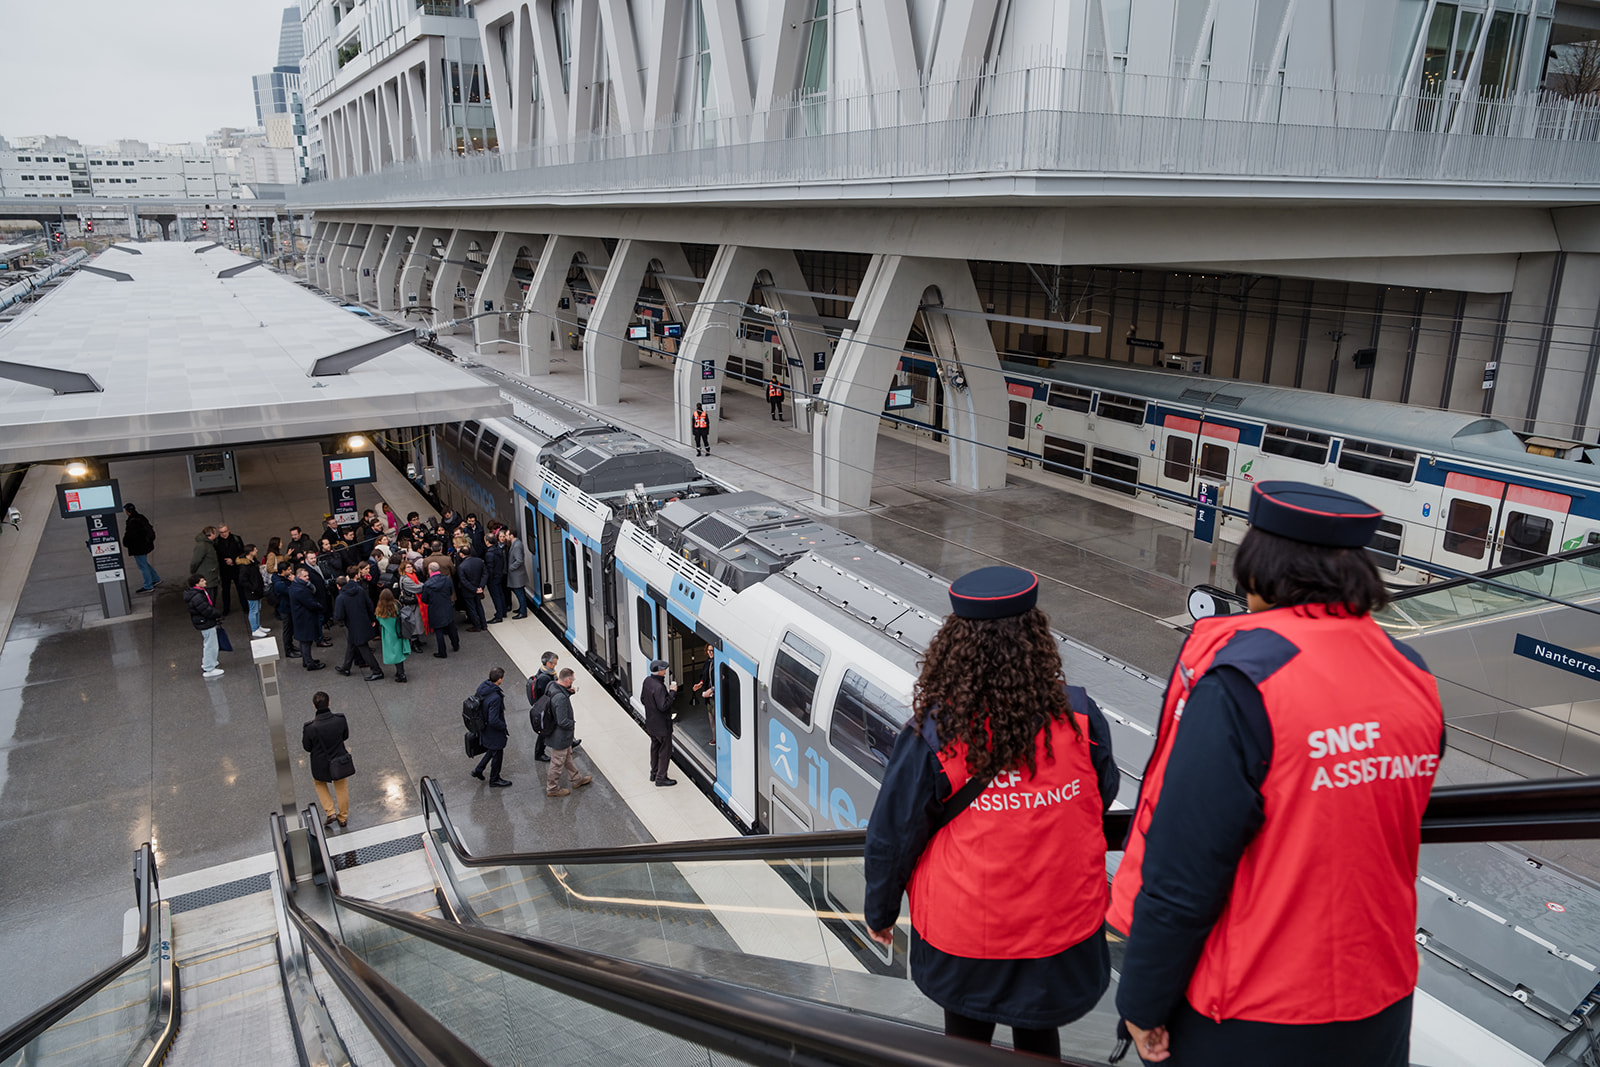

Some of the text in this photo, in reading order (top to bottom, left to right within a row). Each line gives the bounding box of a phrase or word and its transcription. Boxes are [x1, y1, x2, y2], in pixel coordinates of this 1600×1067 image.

[342, 490, 350, 499] C
[94, 519, 103, 528] B
[1308, 722, 1380, 759] SNCF
[1311, 754, 1439, 791] ASSISTANCE
[970, 779, 1080, 811] ASSISTANCE
